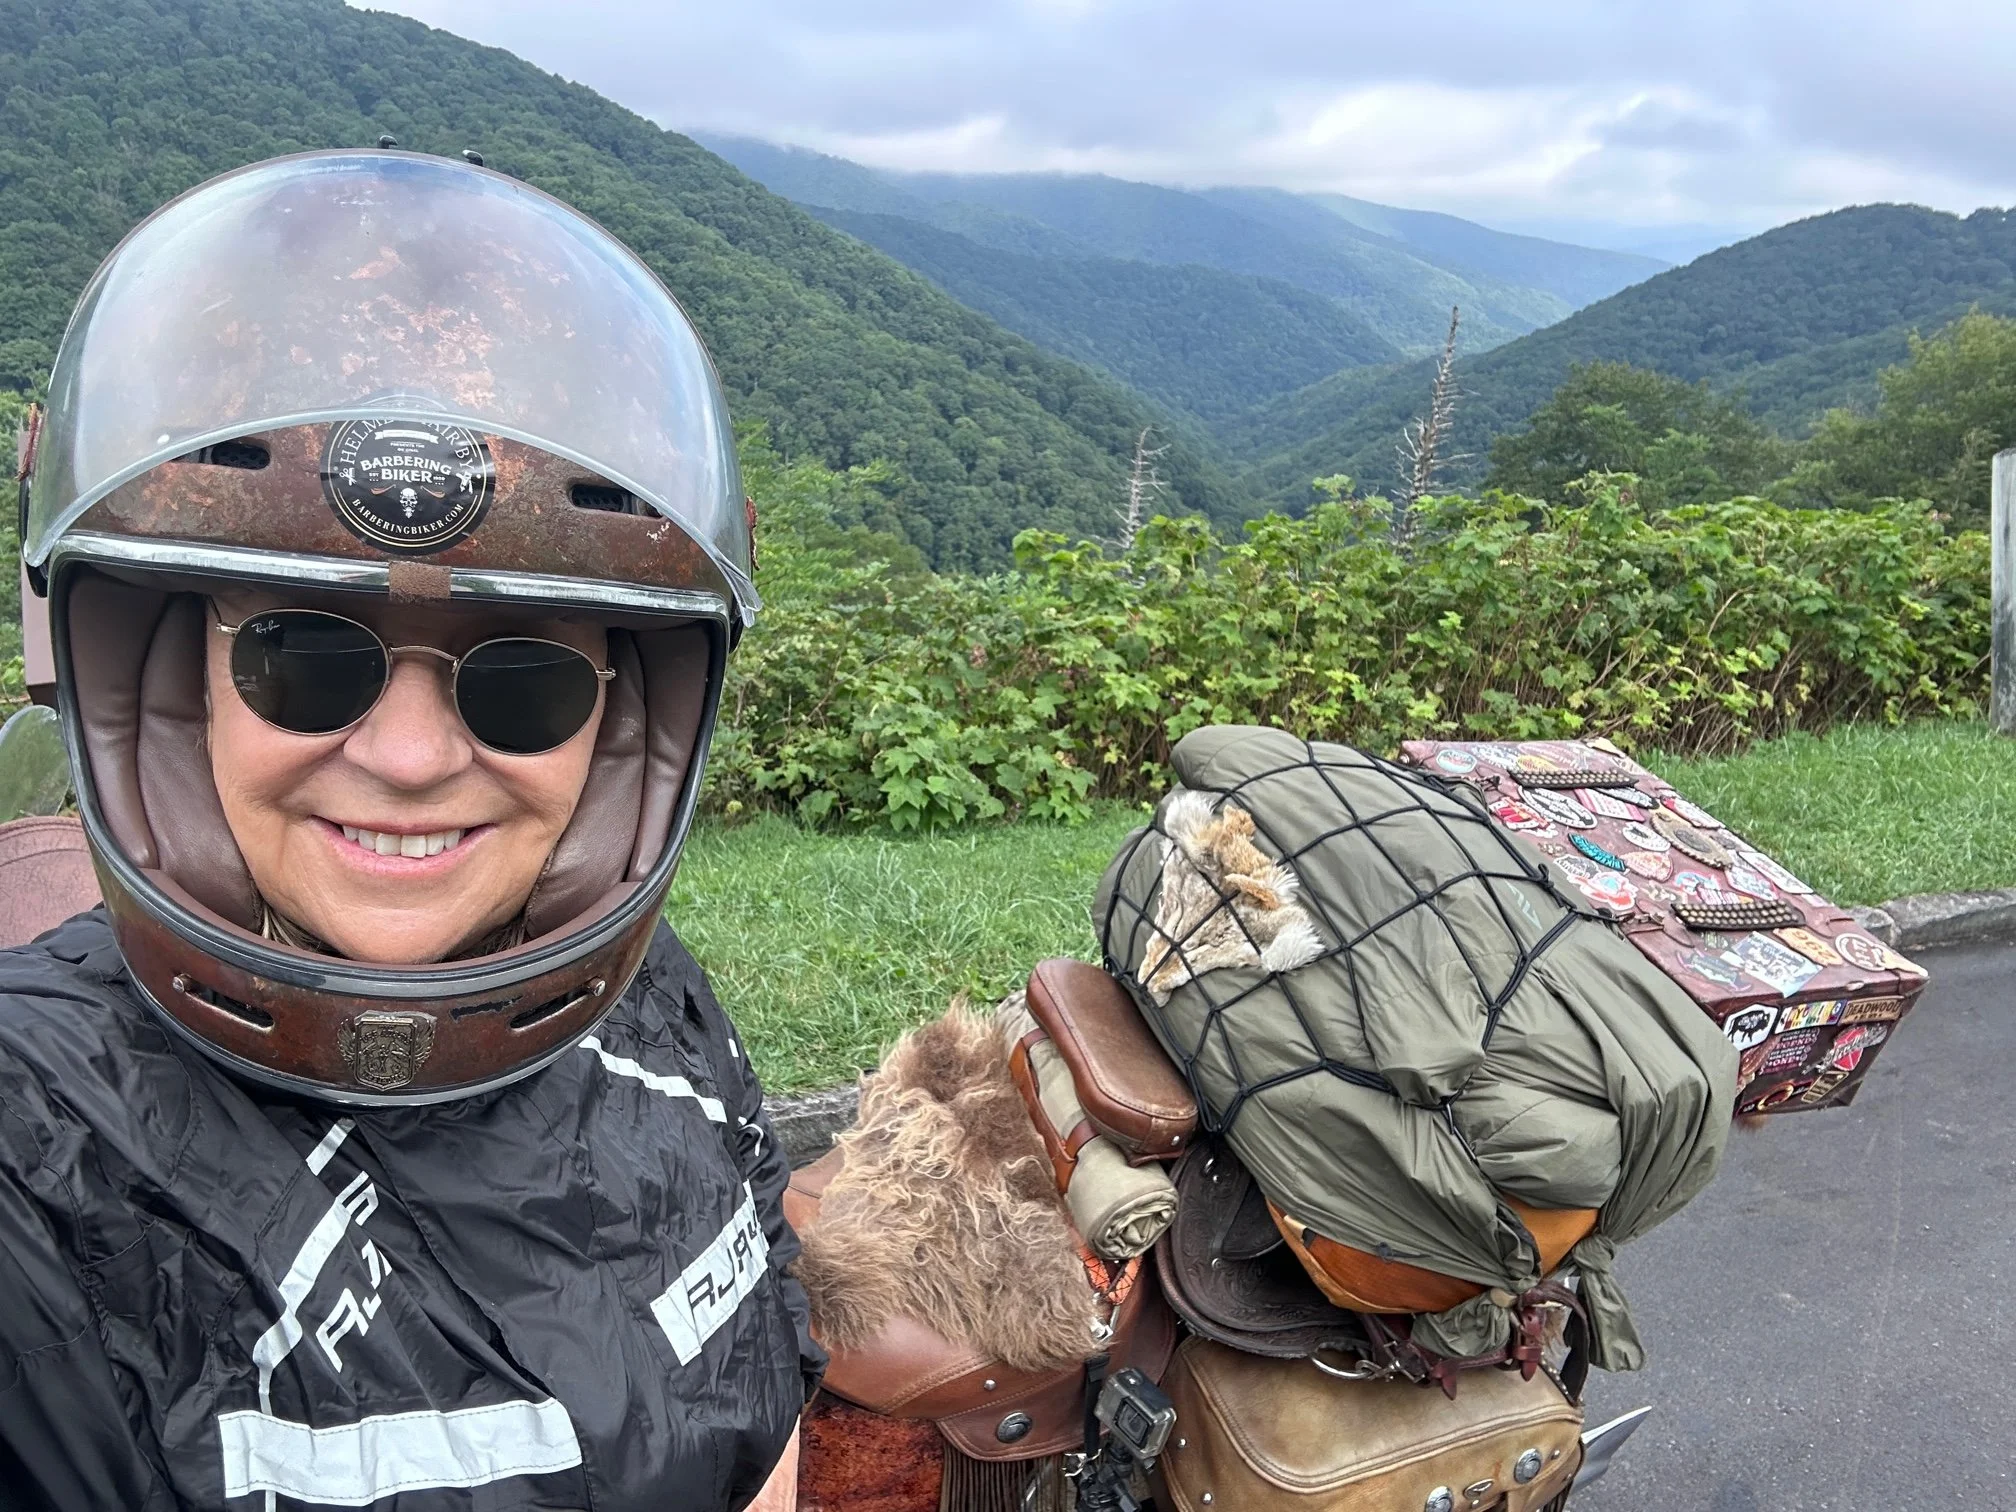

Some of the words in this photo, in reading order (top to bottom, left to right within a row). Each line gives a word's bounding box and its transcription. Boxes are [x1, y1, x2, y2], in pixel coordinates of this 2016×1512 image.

[340, 419, 393, 464] HELM
[422, 420, 460, 445] AIR
[455, 447, 475, 470] BY
[360, 455, 452, 475] BARBERING
[381, 468, 432, 484] BIKER
[352, 498, 464, 535] BARBERINGBIKER.COM
[1848, 1000, 1900, 1015] DEADWOOD
